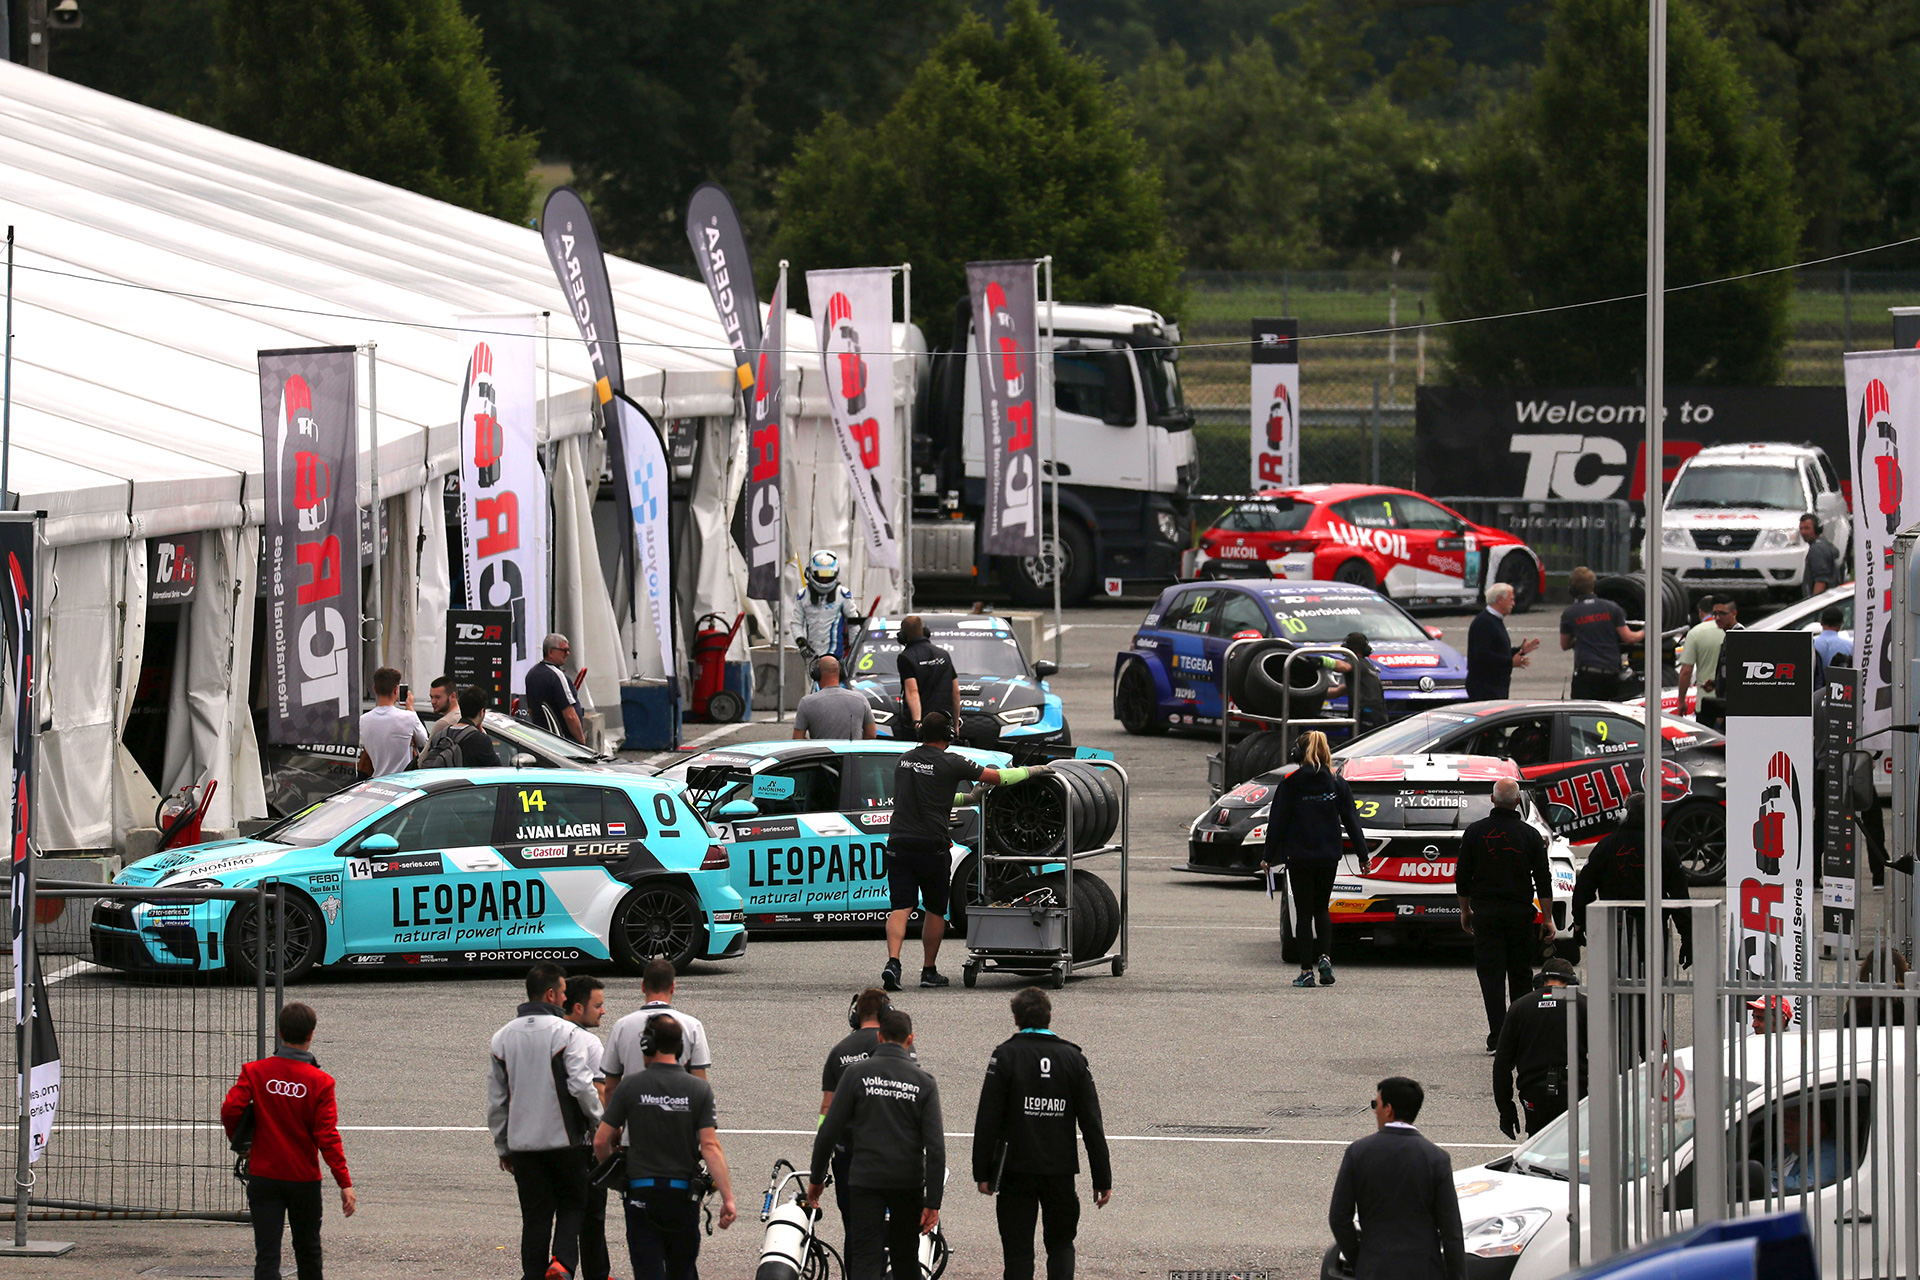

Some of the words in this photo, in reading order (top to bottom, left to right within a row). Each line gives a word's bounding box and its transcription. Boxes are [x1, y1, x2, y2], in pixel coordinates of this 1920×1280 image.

[1516, 401, 1668, 424] Welcom
[1680, 401, 1714, 424] to
[446, 474, 460, 491] TC
[1327, 520, 1411, 560] LUKOIL
[1221, 545, 1258, 560] LUKOIL
[1191, 596, 1207, 613] 10
[1293, 607, 1361, 618] Morbidelli
[455, 623, 503, 640] TCR
[1281, 617, 1307, 634] 10
[886, 630, 993, 639] T-series.com
[863, 645, 876, 653] F.
[858, 653, 874, 670] 6
[1180, 655, 1213, 672] TEGERA
[1742, 661, 1796, 680] TCR
[1830, 682, 1853, 701] TCR
[1596, 721, 1608, 741] 9
[1584, 746, 1596, 756] A.
[1597, 741, 1628, 754] Tassi
[757, 786, 786, 794] ANONIMO
[519, 790, 547, 813] 14
[1394, 797, 1418, 808] P.-Y.
[1420, 795, 1469, 808] Corthals
[871, 814, 892, 824] Cast
[516, 825, 554, 840] J.VAN
[556, 823, 601, 838] LAGEN
[717, 826, 729, 840] 2
[736, 824, 796, 837] TCR-series.com
[532, 846, 566, 858] Castrol
[573, 842, 630, 856] EDGE
[189, 858, 254, 877] ANONIMO
[349, 862, 370, 878] 14
[371, 859, 441, 873] TCR-series.com
[749, 841, 889, 887] LEOPARD
[1399, 862, 1458, 877] MOTU
[309, 873, 340, 885] FEBO
[392, 878, 546, 928] LEOPARD
[749, 889, 803, 905] natural
[805, 888, 849, 906] power
[852, 885, 889, 900] drink
[1793, 878, 1803, 927] Series
[827, 911, 919, 922] PORTOPICCO
[1396, 903, 1462, 916] TCR-series.co
[394, 927, 453, 943] natural
[455, 927, 502, 944] power
[506, 920, 546, 936] drink
[480, 950, 580, 962] PORTOPICCOLO
[1793, 932, 1801, 1026] Inteational
[839, 1052, 869, 1065] WestC
[862, 1076, 921, 1094] Volkswagen
[640, 1094, 690, 1105] WestCoast
[865, 1086, 917, 1102] Motorsport
[1024, 1096, 1067, 1112] LEOPARD
